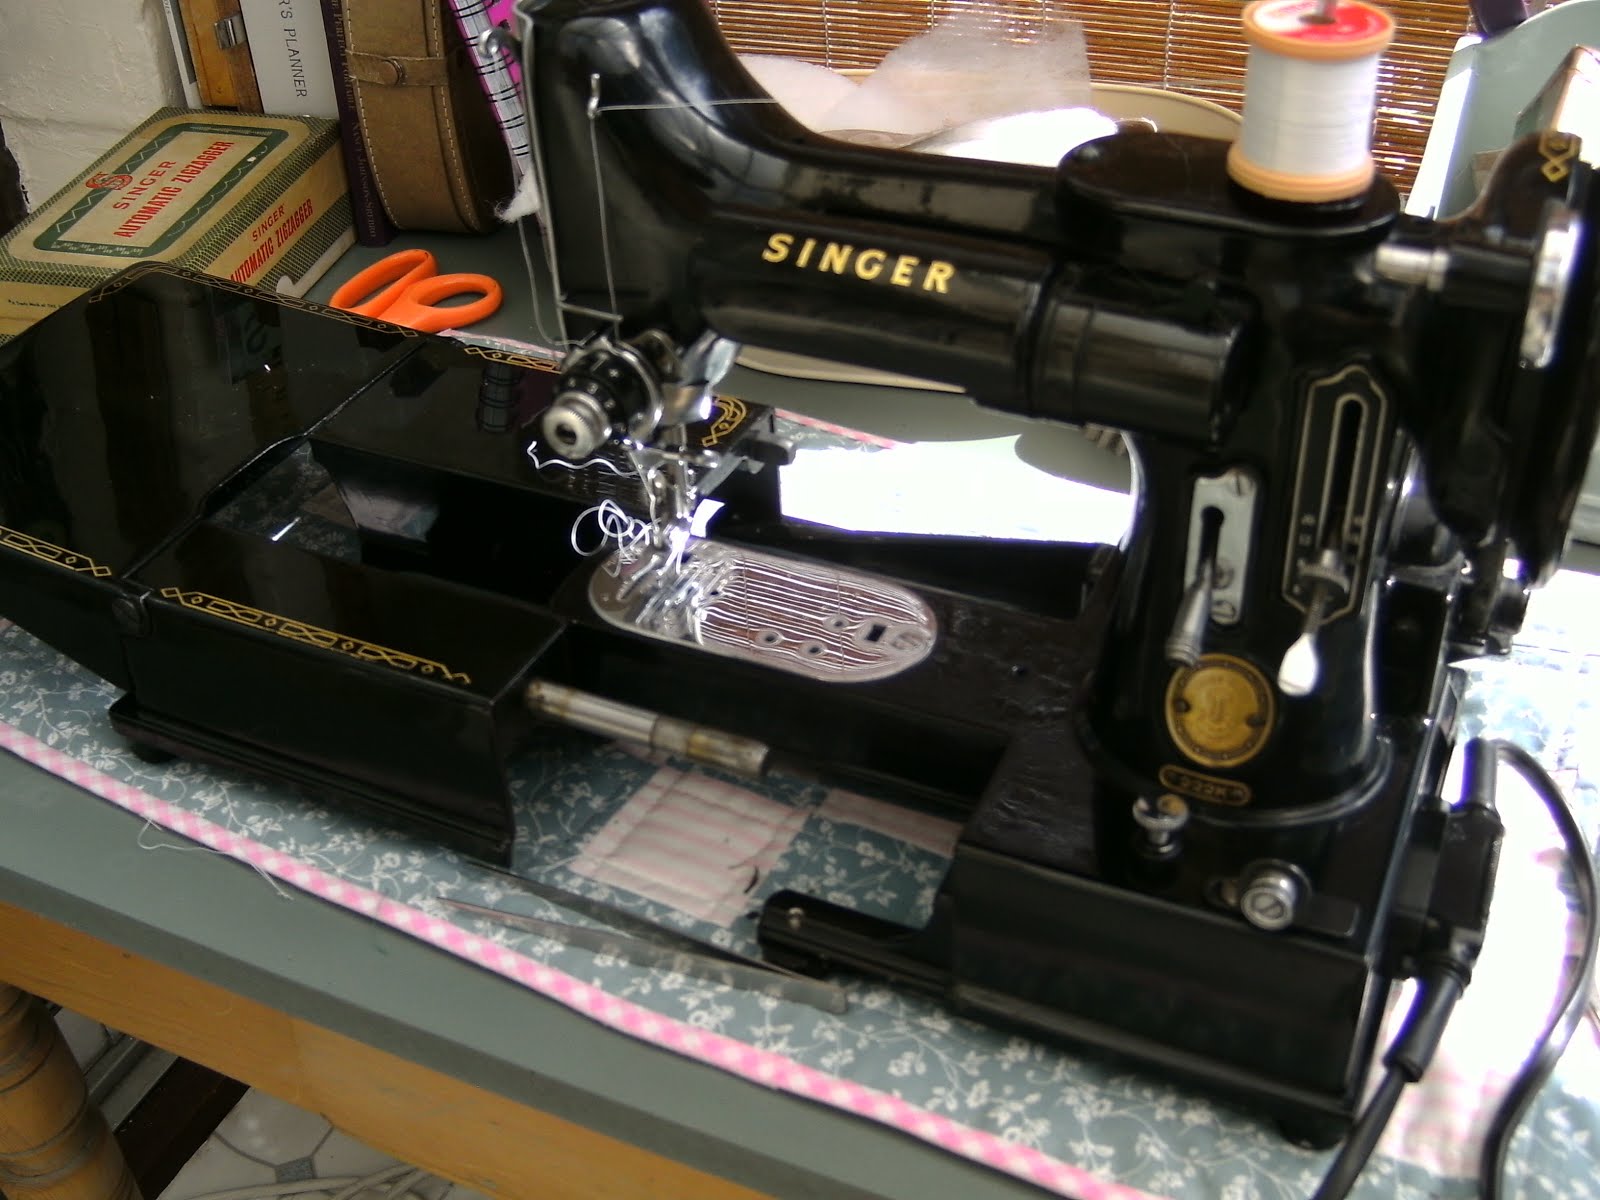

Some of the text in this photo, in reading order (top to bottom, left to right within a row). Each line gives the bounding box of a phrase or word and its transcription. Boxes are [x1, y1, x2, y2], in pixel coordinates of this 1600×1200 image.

[284, 28, 308, 97] PLANNER
[112, 161, 177, 210] SINGER
[113, 140, 236, 239] AUTOMATIC ZIGZAGGER
[252, 204, 286, 242] SINGER
[274, 197, 314, 248] ZIGZAGGER
[762, 233, 955, 294] SINGER
